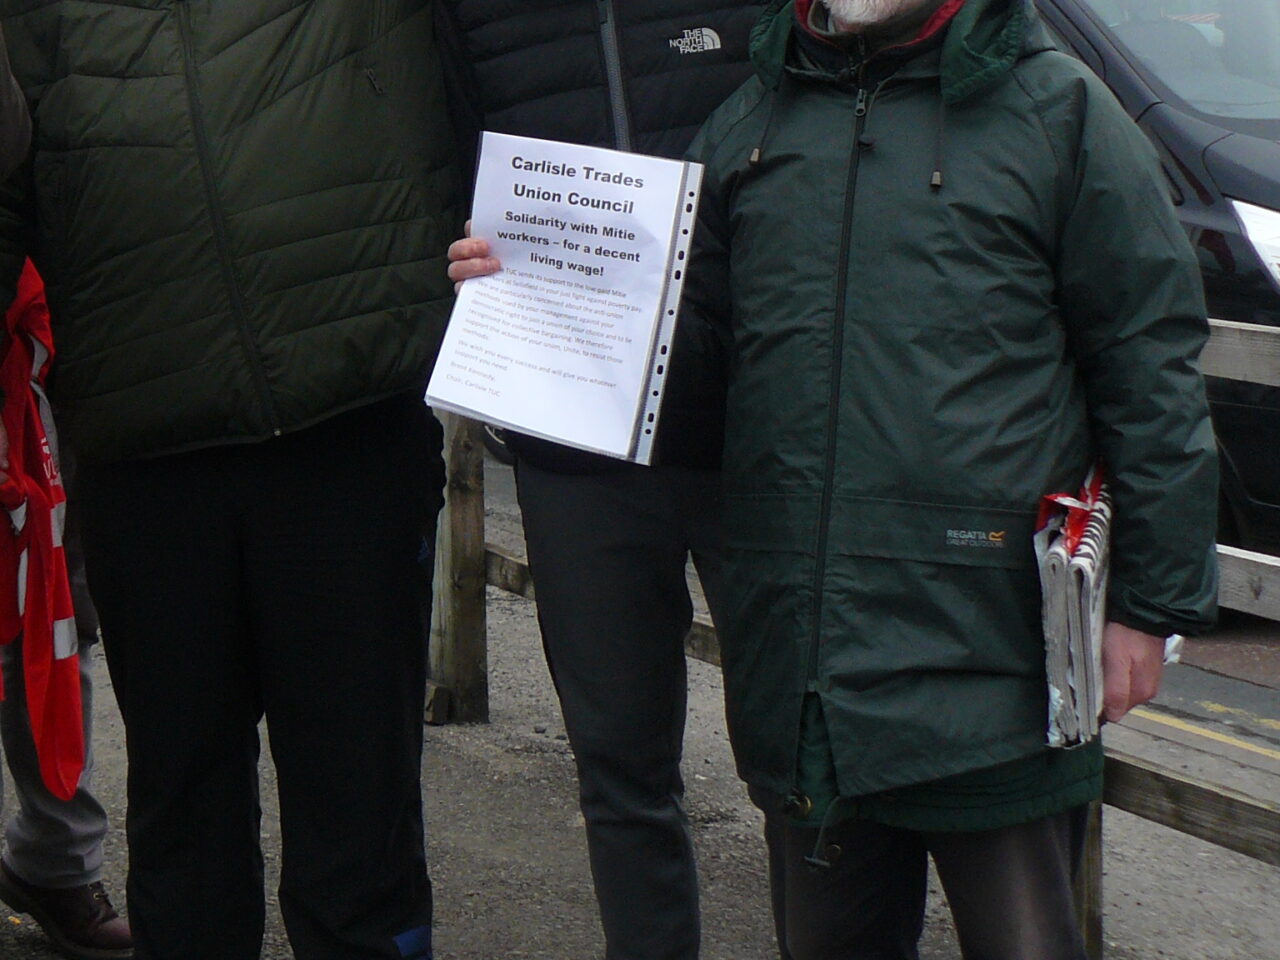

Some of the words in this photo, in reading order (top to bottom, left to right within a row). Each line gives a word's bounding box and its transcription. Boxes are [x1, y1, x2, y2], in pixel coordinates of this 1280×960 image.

[669, 37, 703, 48] NORTH
[682, 28, 702, 39] THE
[680, 45, 704, 54] FACE
[511, 156, 576, 177] Carlisle
[583, 166, 643, 187] Trades
[513, 183, 561, 202] Union
[567, 192, 633, 213] Council
[505, 211, 566, 230] Solidarity
[570, 222, 597, 234] with
[602, 226, 635, 240] Mitie
[497, 231, 549, 245] workers
[563, 238, 580, 250] for
[583, 245, 590, 253] a
[594, 246, 639, 262] decent
[530, 252, 563, 269] living
[567, 262, 603, 276] wage!
[946, 529, 987, 540] REGATTA
